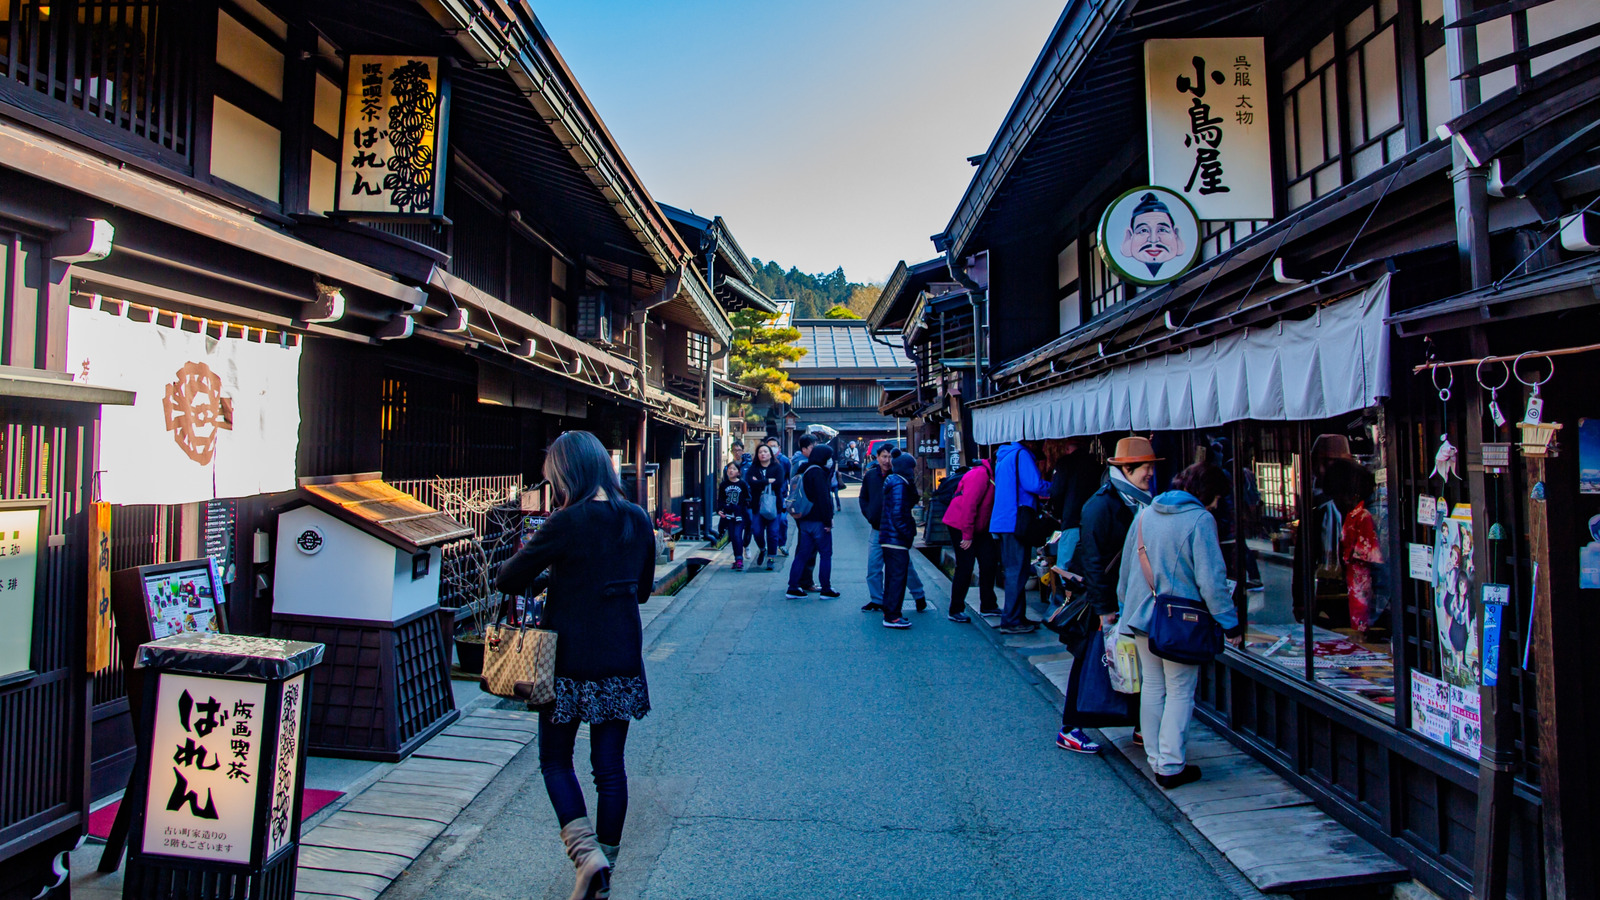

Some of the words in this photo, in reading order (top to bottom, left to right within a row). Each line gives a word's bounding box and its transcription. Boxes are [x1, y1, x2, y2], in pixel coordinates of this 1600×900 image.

[361, 63, 382, 121] 版画喫茶
[1233, 56, 1252, 87] 呉服
[1176, 56, 1230, 195] 小鳥屋
[1235, 94, 1254, 125] 太物
[351, 126, 389, 195] ばれん
[166, 689, 229, 820] ばれん
[226, 699, 255, 784] 版画喫茶
[164, 826, 227, 840] 古い町家造りの
